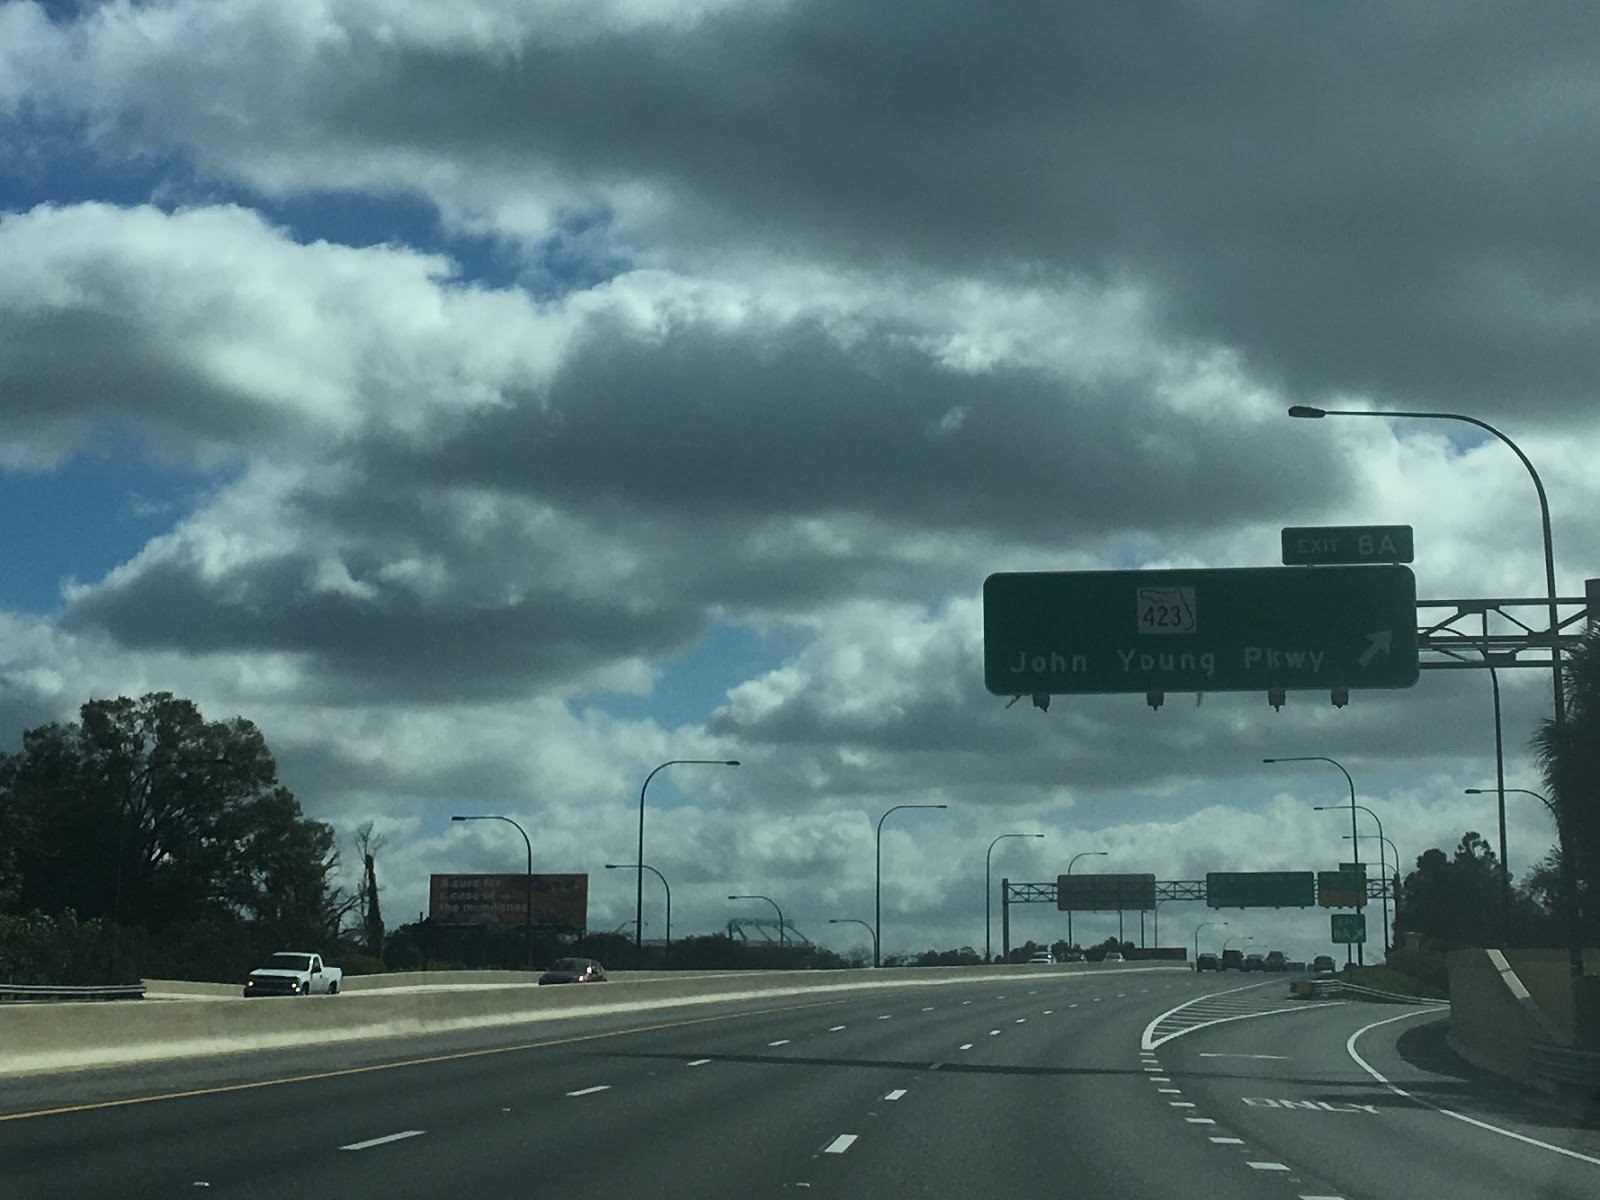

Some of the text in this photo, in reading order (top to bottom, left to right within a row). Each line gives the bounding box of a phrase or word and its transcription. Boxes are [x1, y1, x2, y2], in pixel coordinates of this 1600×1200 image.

[1297, 534, 1398, 555] EXIT 8A
[1143, 606, 1181, 627] 423
[1009, 647, 1326, 677] John Young Pkwy
[439, 902, 459, 912] the
[1241, 1097, 1380, 1115] ONLY
